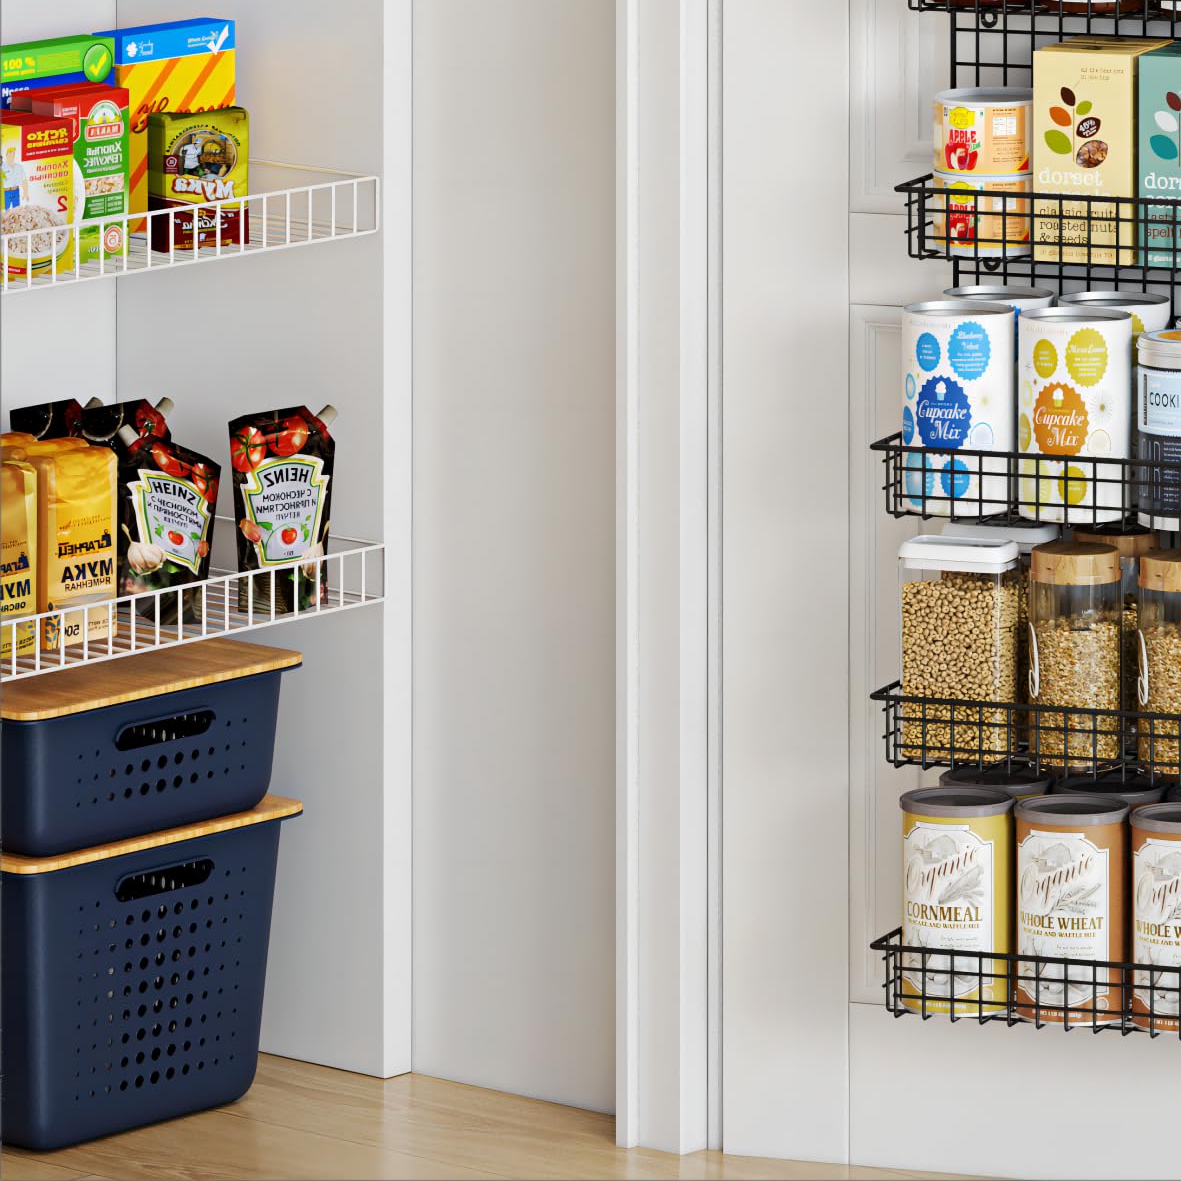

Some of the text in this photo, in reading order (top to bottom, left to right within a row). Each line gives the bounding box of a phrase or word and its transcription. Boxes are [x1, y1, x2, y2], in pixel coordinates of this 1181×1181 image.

[949, 129, 976, 145] APPLE
[1039, 167, 1103, 186] dorset
[1039, 206, 1082, 218] clasic
[1039, 221, 1086, 232] roasted
[918, 399, 967, 424] Cupcake
[1035, 405, 1085, 430] Cupcake
[930, 420, 962, 440] Mix
[1047, 427, 1079, 447] Mix
[152, 481, 196, 506] HEINZ
[906, 845, 980, 900] Organic
[1021, 853, 1094, 908] Organic
[907, 900, 983, 922] CORNMEAL
[1020, 910, 1104, 930] WHOLE WHEAT
[1135, 919, 1171, 938] WHOLE
